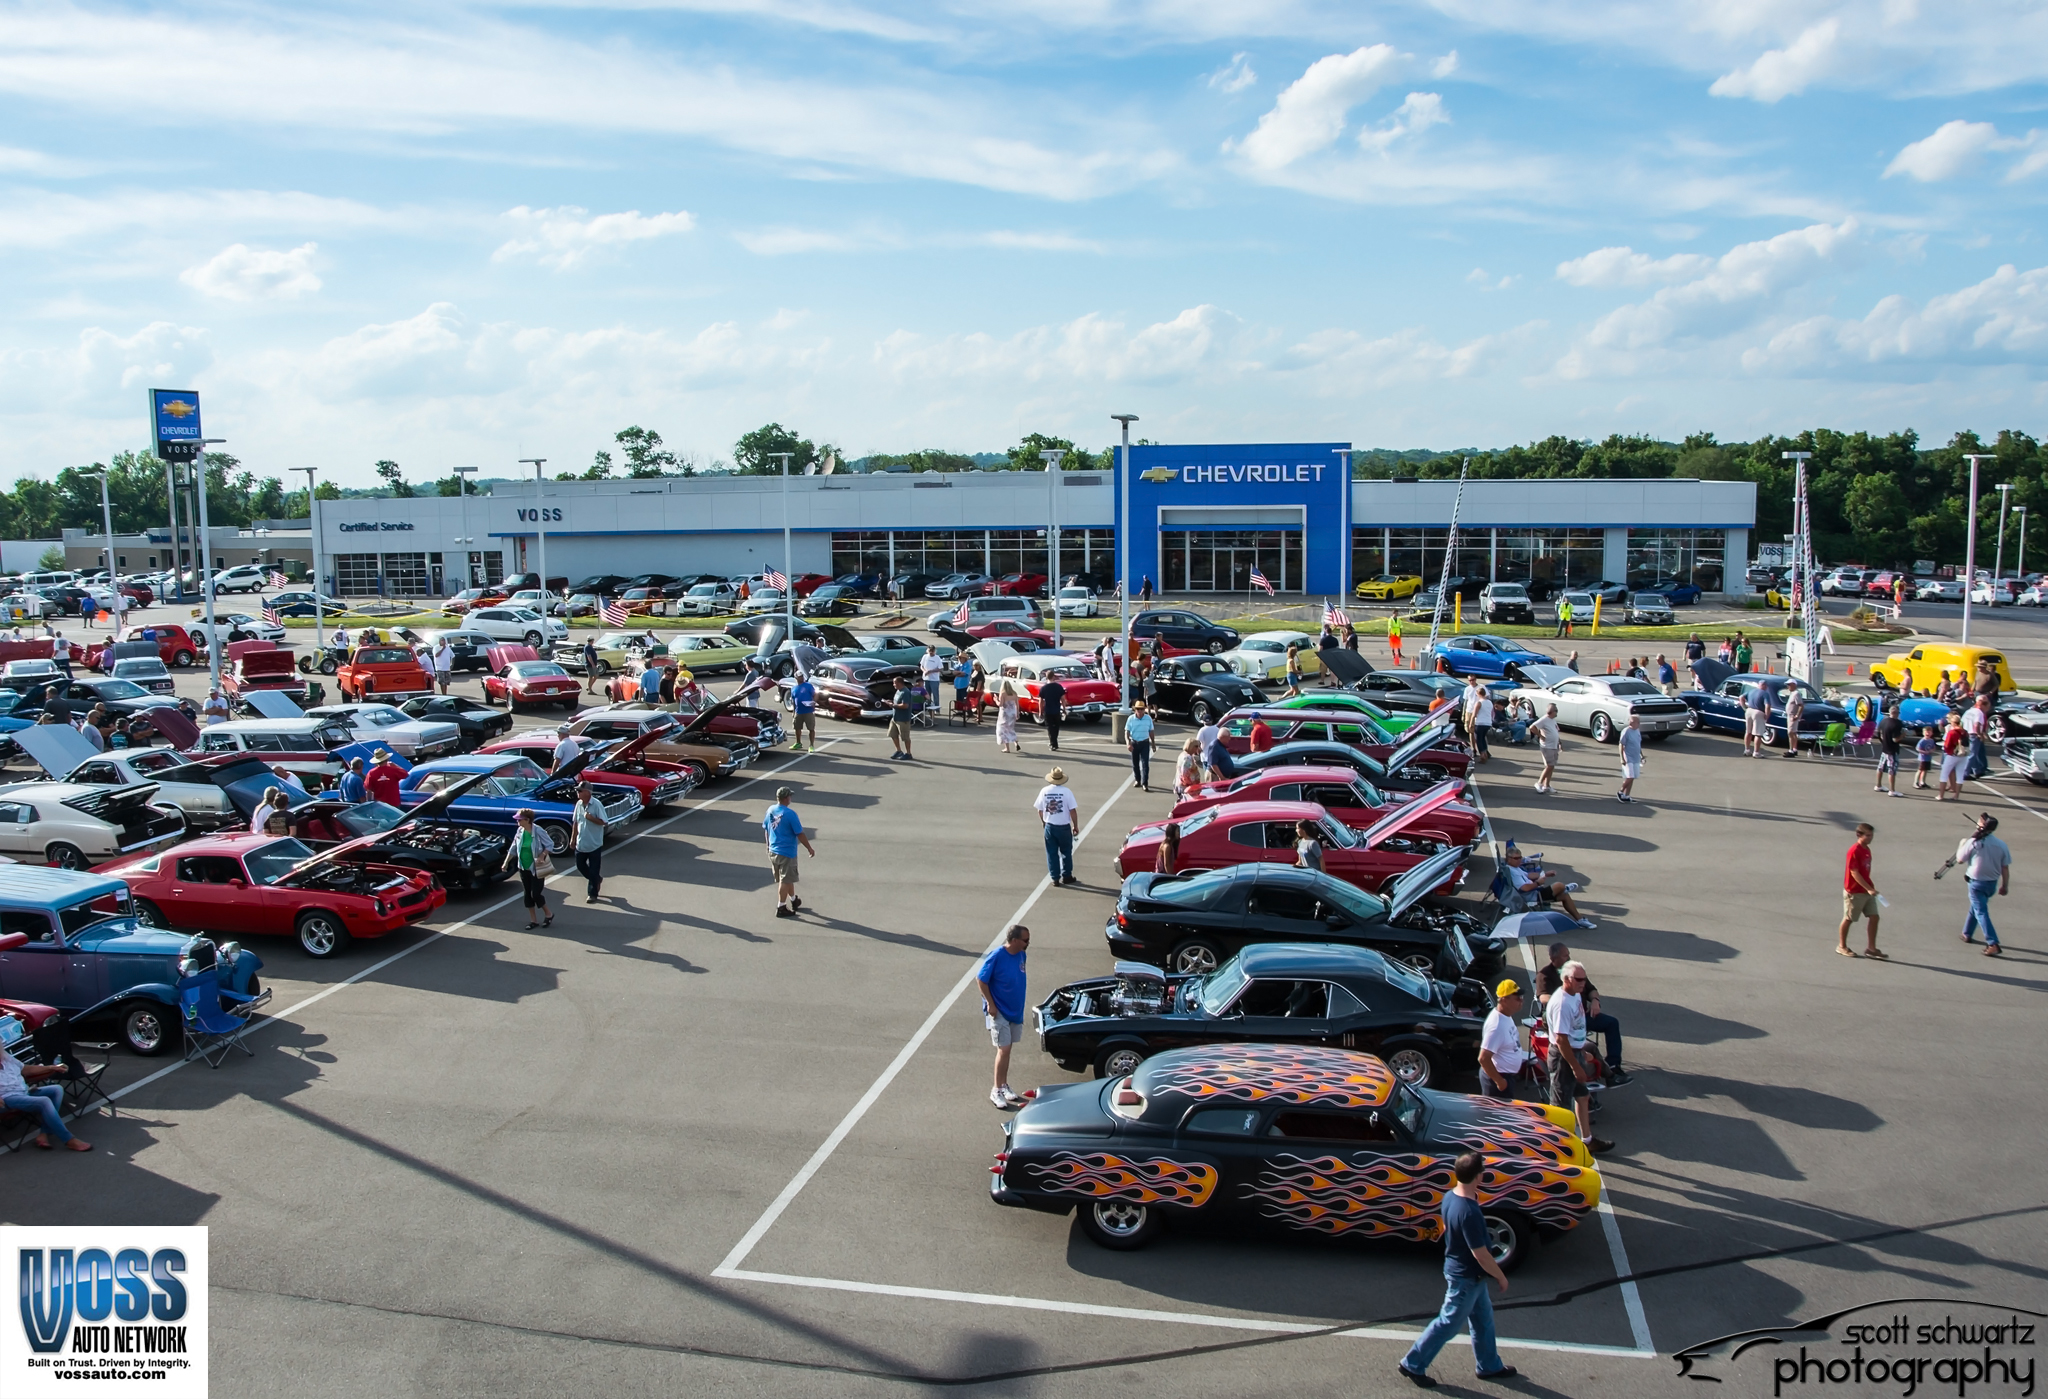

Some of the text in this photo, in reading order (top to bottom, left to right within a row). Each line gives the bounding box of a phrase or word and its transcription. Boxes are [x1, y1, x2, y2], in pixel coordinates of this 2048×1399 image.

[161, 427, 198, 435] CHEVROLET
[167, 445, 196, 454] VOSS
[1183, 464, 1326, 483] CHEVROLET
[517, 507, 563, 522] VOSS
[339, 521, 413, 532] Certified Service
[1760, 545, 1783, 556] VOSS
